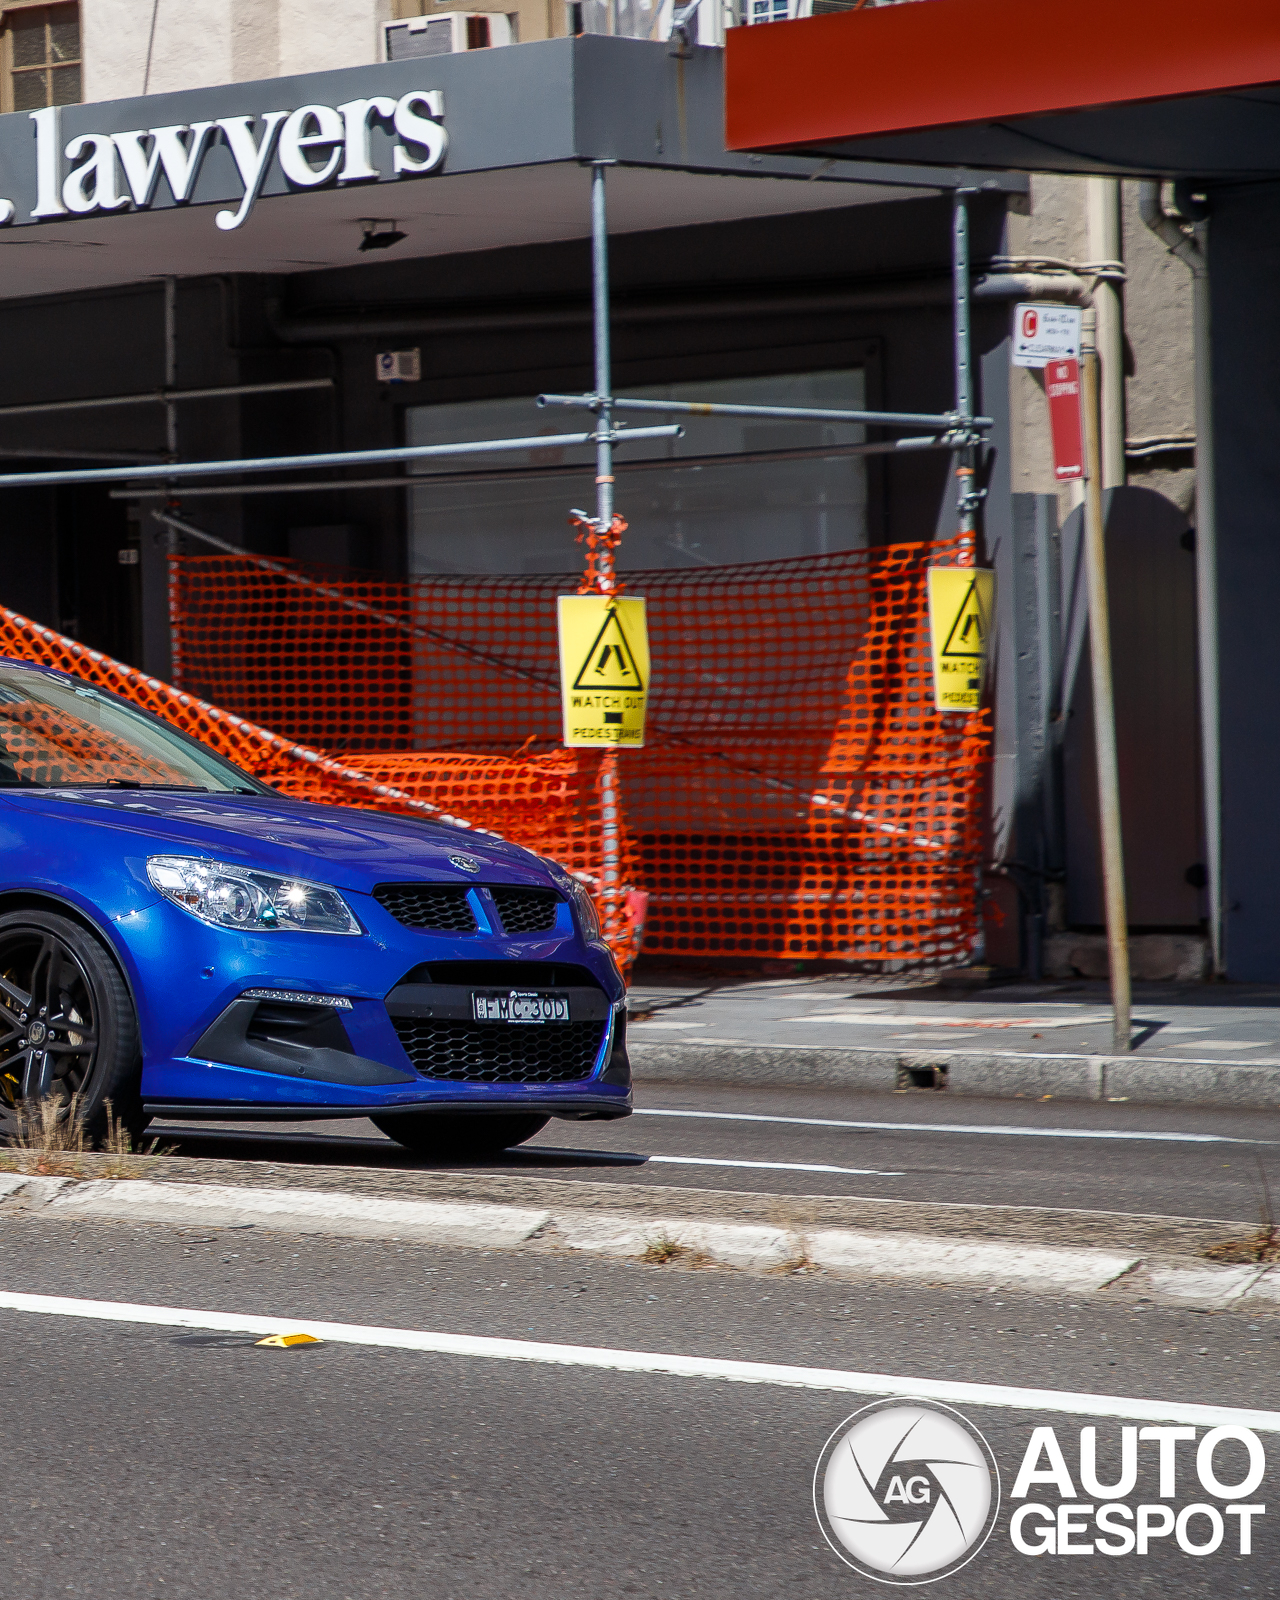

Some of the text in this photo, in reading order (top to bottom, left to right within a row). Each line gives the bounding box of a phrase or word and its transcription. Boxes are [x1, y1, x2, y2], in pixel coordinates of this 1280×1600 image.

[29, 90, 449, 231] lawyers
[571, 696, 644, 709] WATCH OUT
